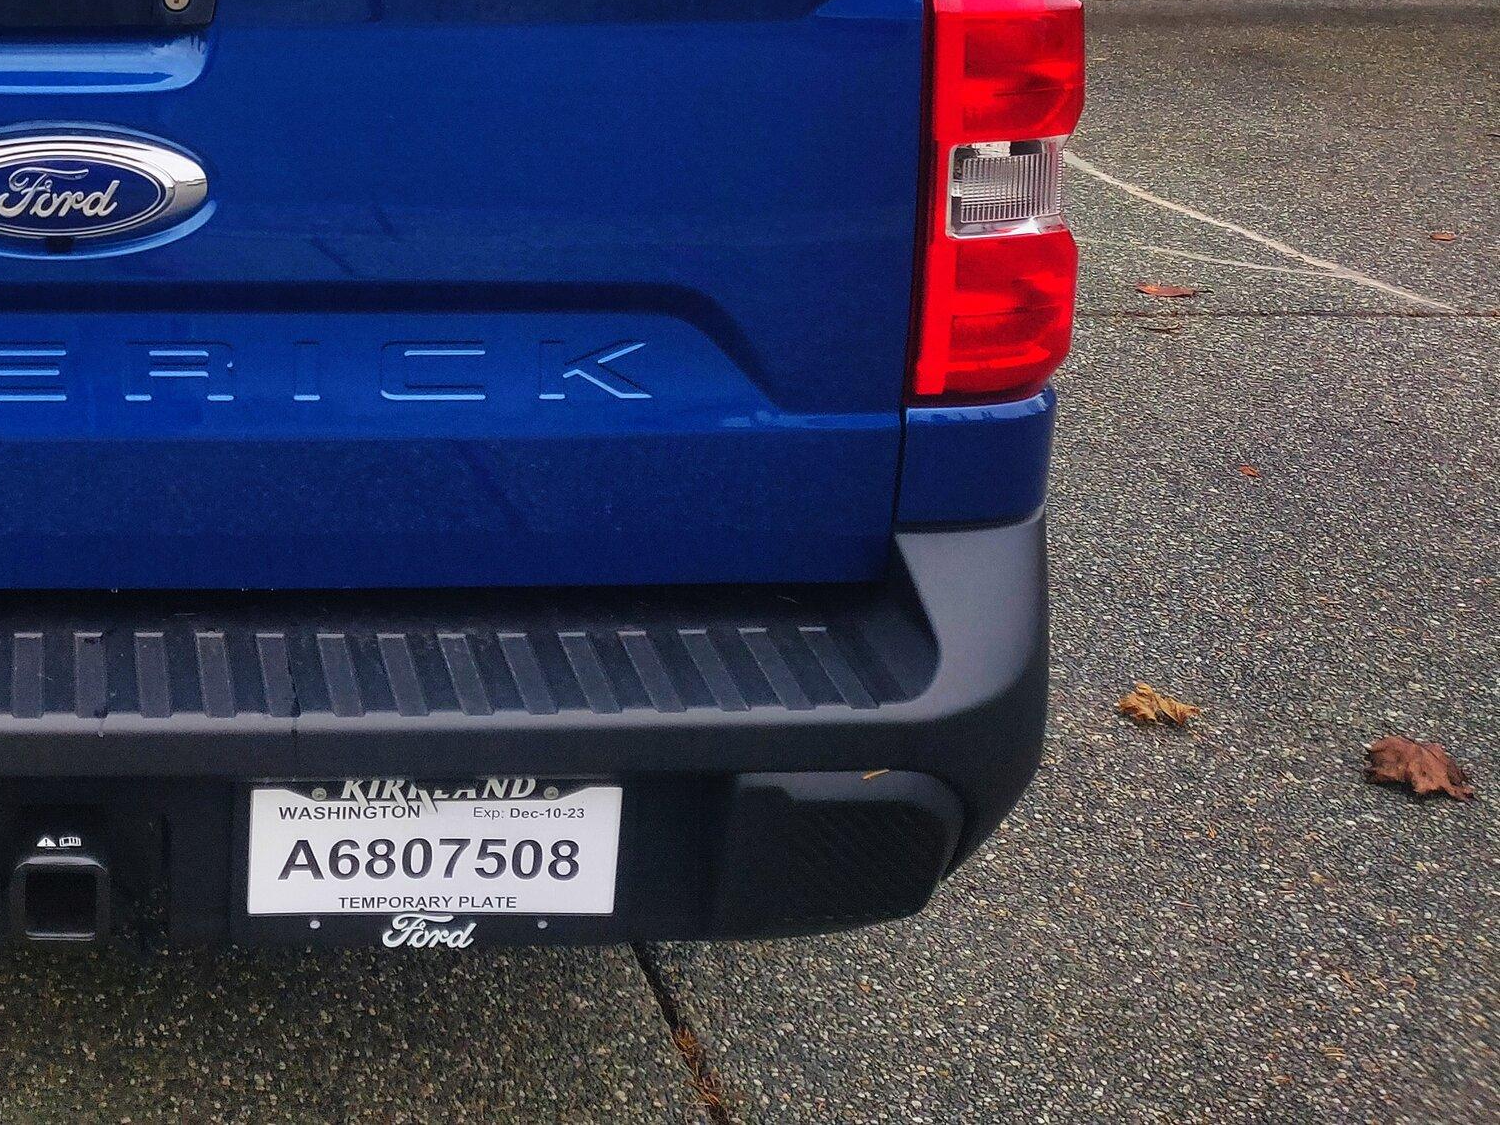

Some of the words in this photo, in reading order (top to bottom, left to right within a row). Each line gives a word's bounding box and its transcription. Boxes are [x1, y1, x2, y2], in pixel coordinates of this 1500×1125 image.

[279, 805, 421, 820] WASHINGTON
[473, 806, 505, 821] Exp:
[510, 807, 585, 819] Dec-10-23
[277, 837, 581, 882] A6807508
[338, 896, 453, 909] TEMPORARY
[458, 896, 518, 909] PLATE
[382, 913, 477, 949] Ford
